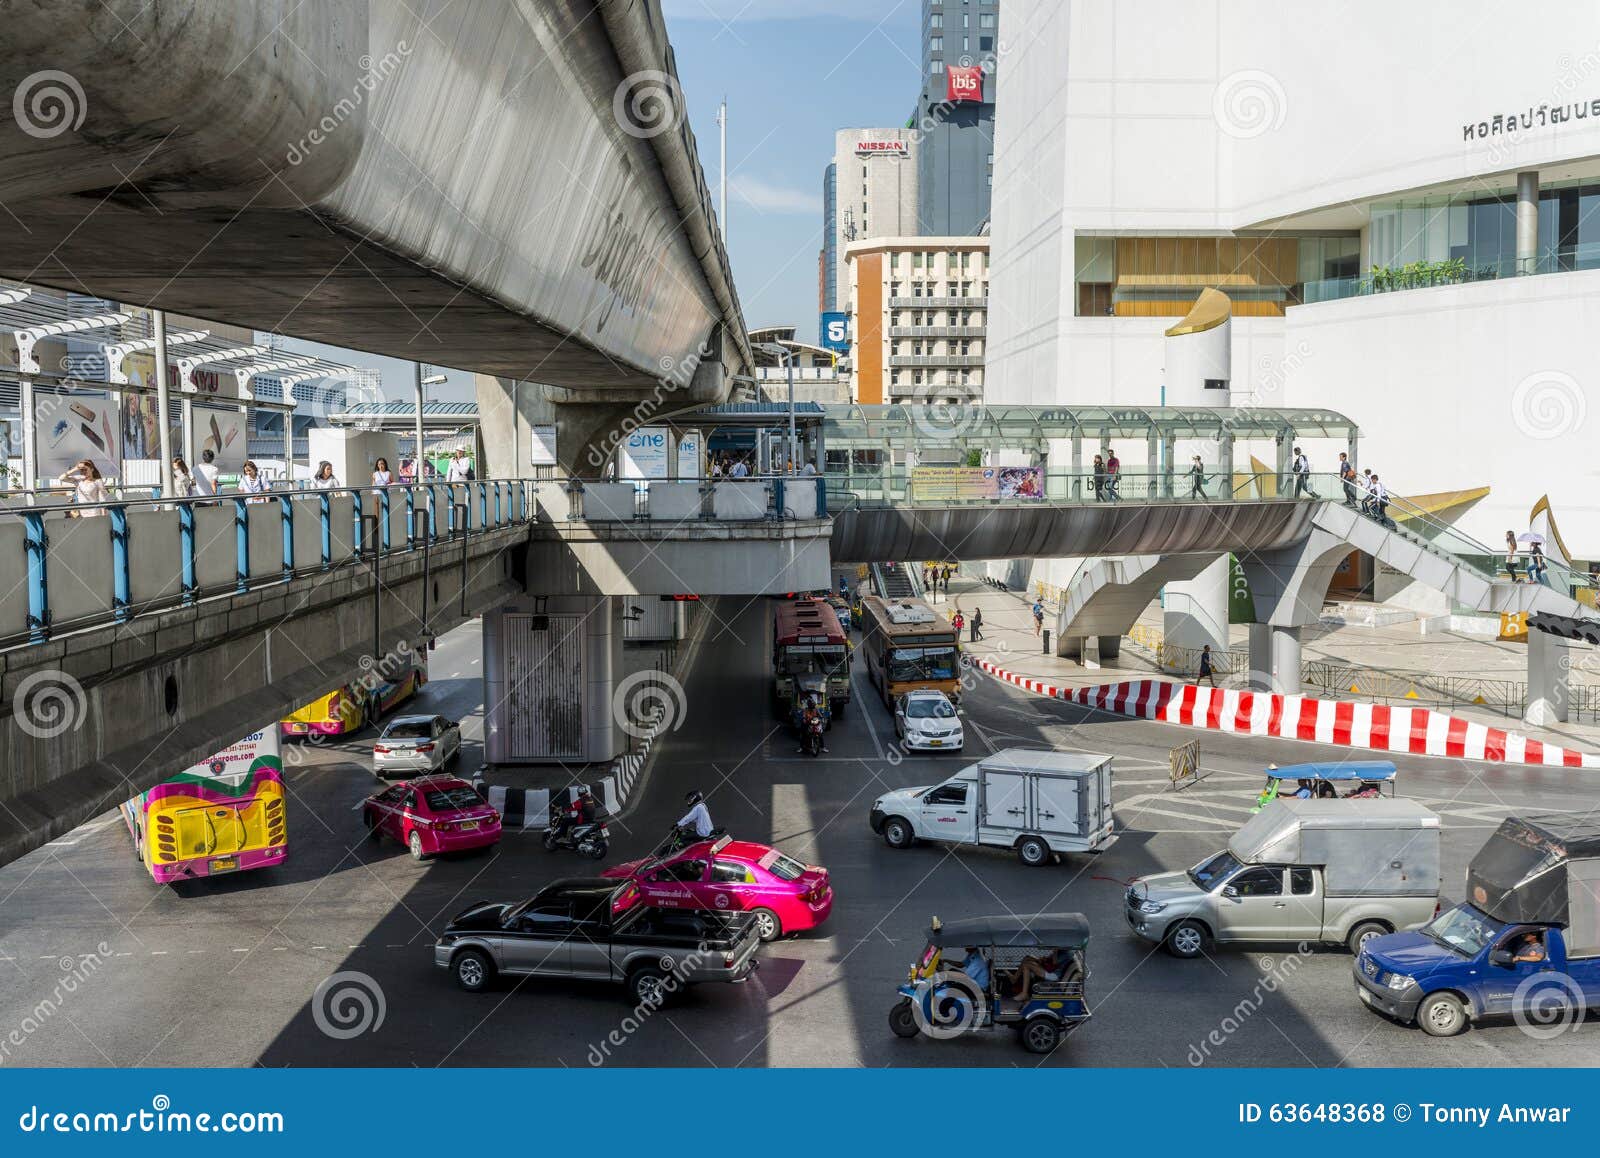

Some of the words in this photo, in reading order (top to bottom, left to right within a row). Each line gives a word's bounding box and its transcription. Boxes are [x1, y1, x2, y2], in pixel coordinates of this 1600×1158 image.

[952, 74, 977, 89] ibis
[858, 142, 903, 150] NISSAN
[169, 365, 218, 392] TKYU
[1087, 476, 1120, 491] bcc
